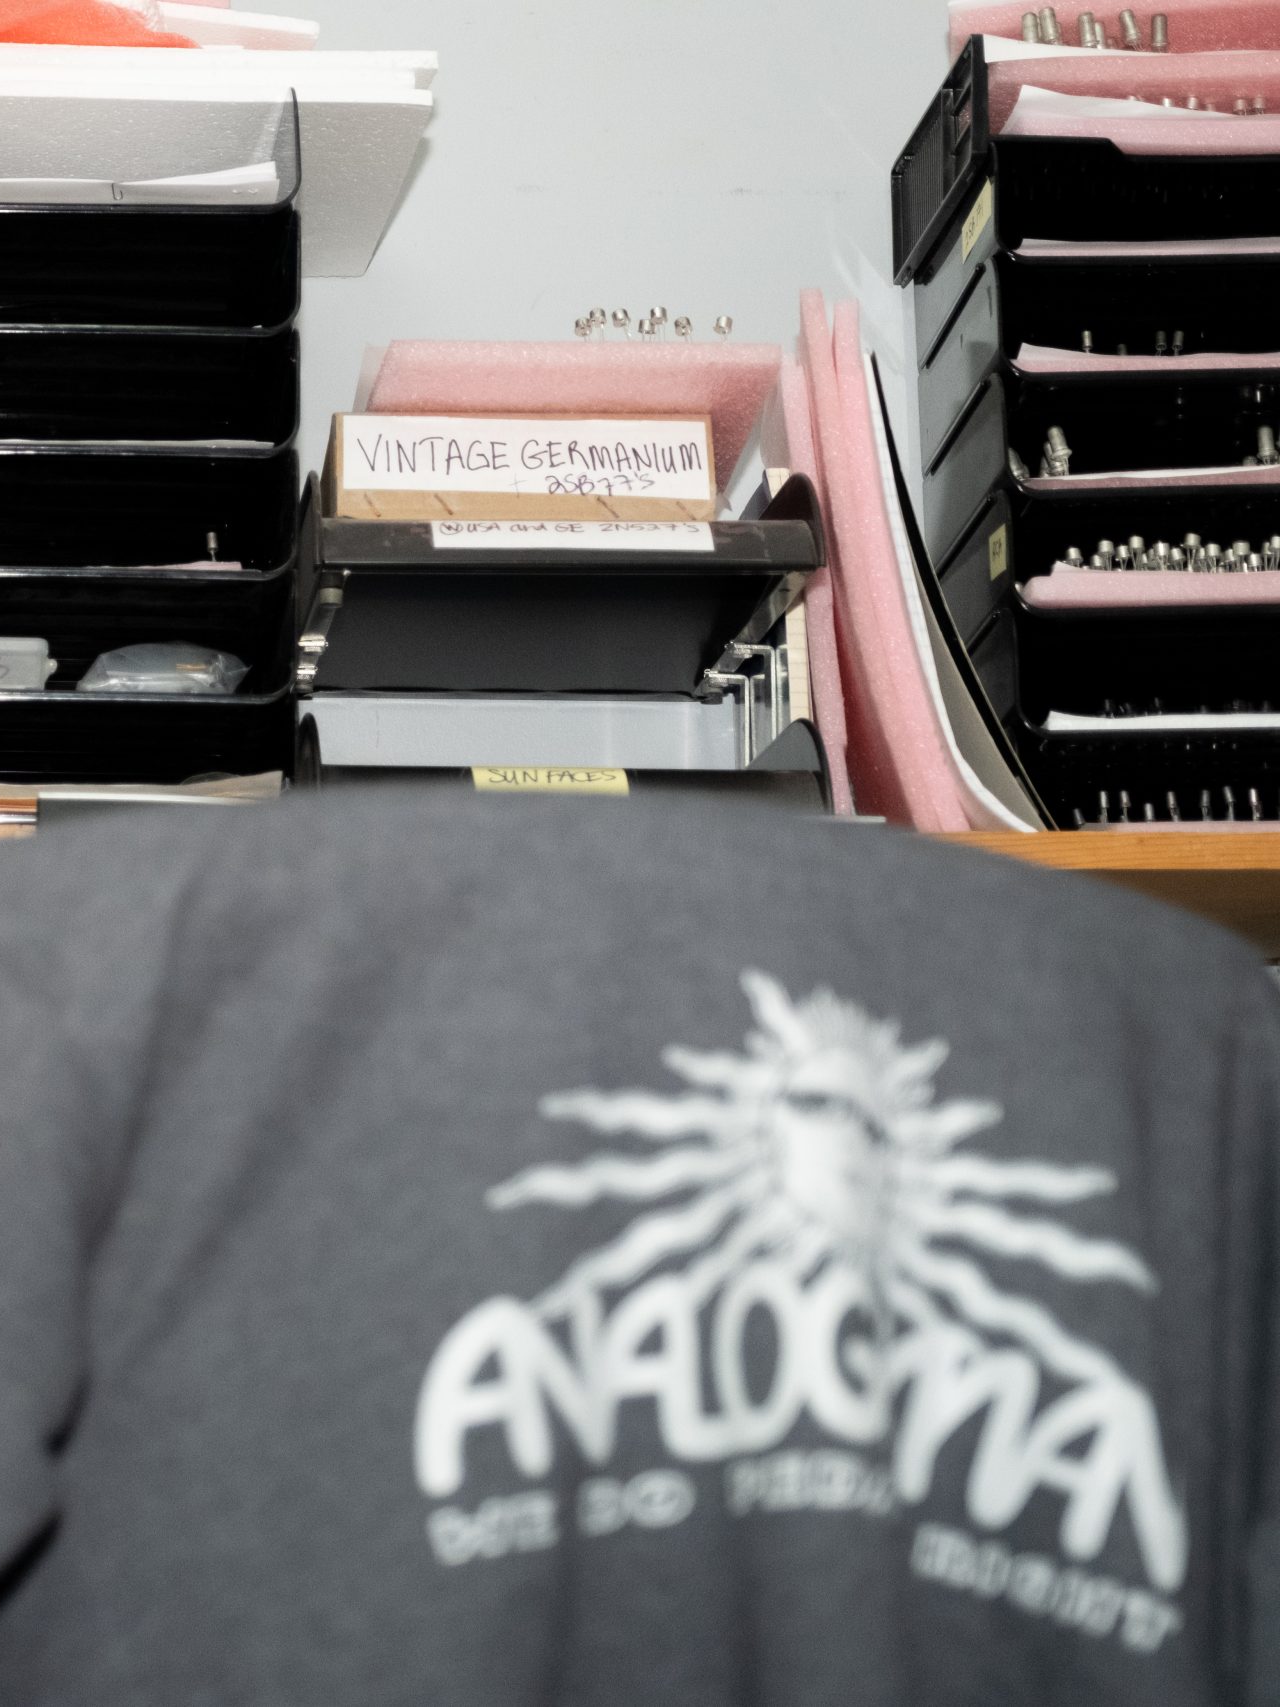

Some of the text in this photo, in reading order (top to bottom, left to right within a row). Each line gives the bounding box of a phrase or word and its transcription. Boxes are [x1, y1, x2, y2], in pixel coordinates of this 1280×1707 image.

[357, 433, 703, 476] VINTAGE GERMANIUM
[488, 768, 617, 785] SUN FACES
